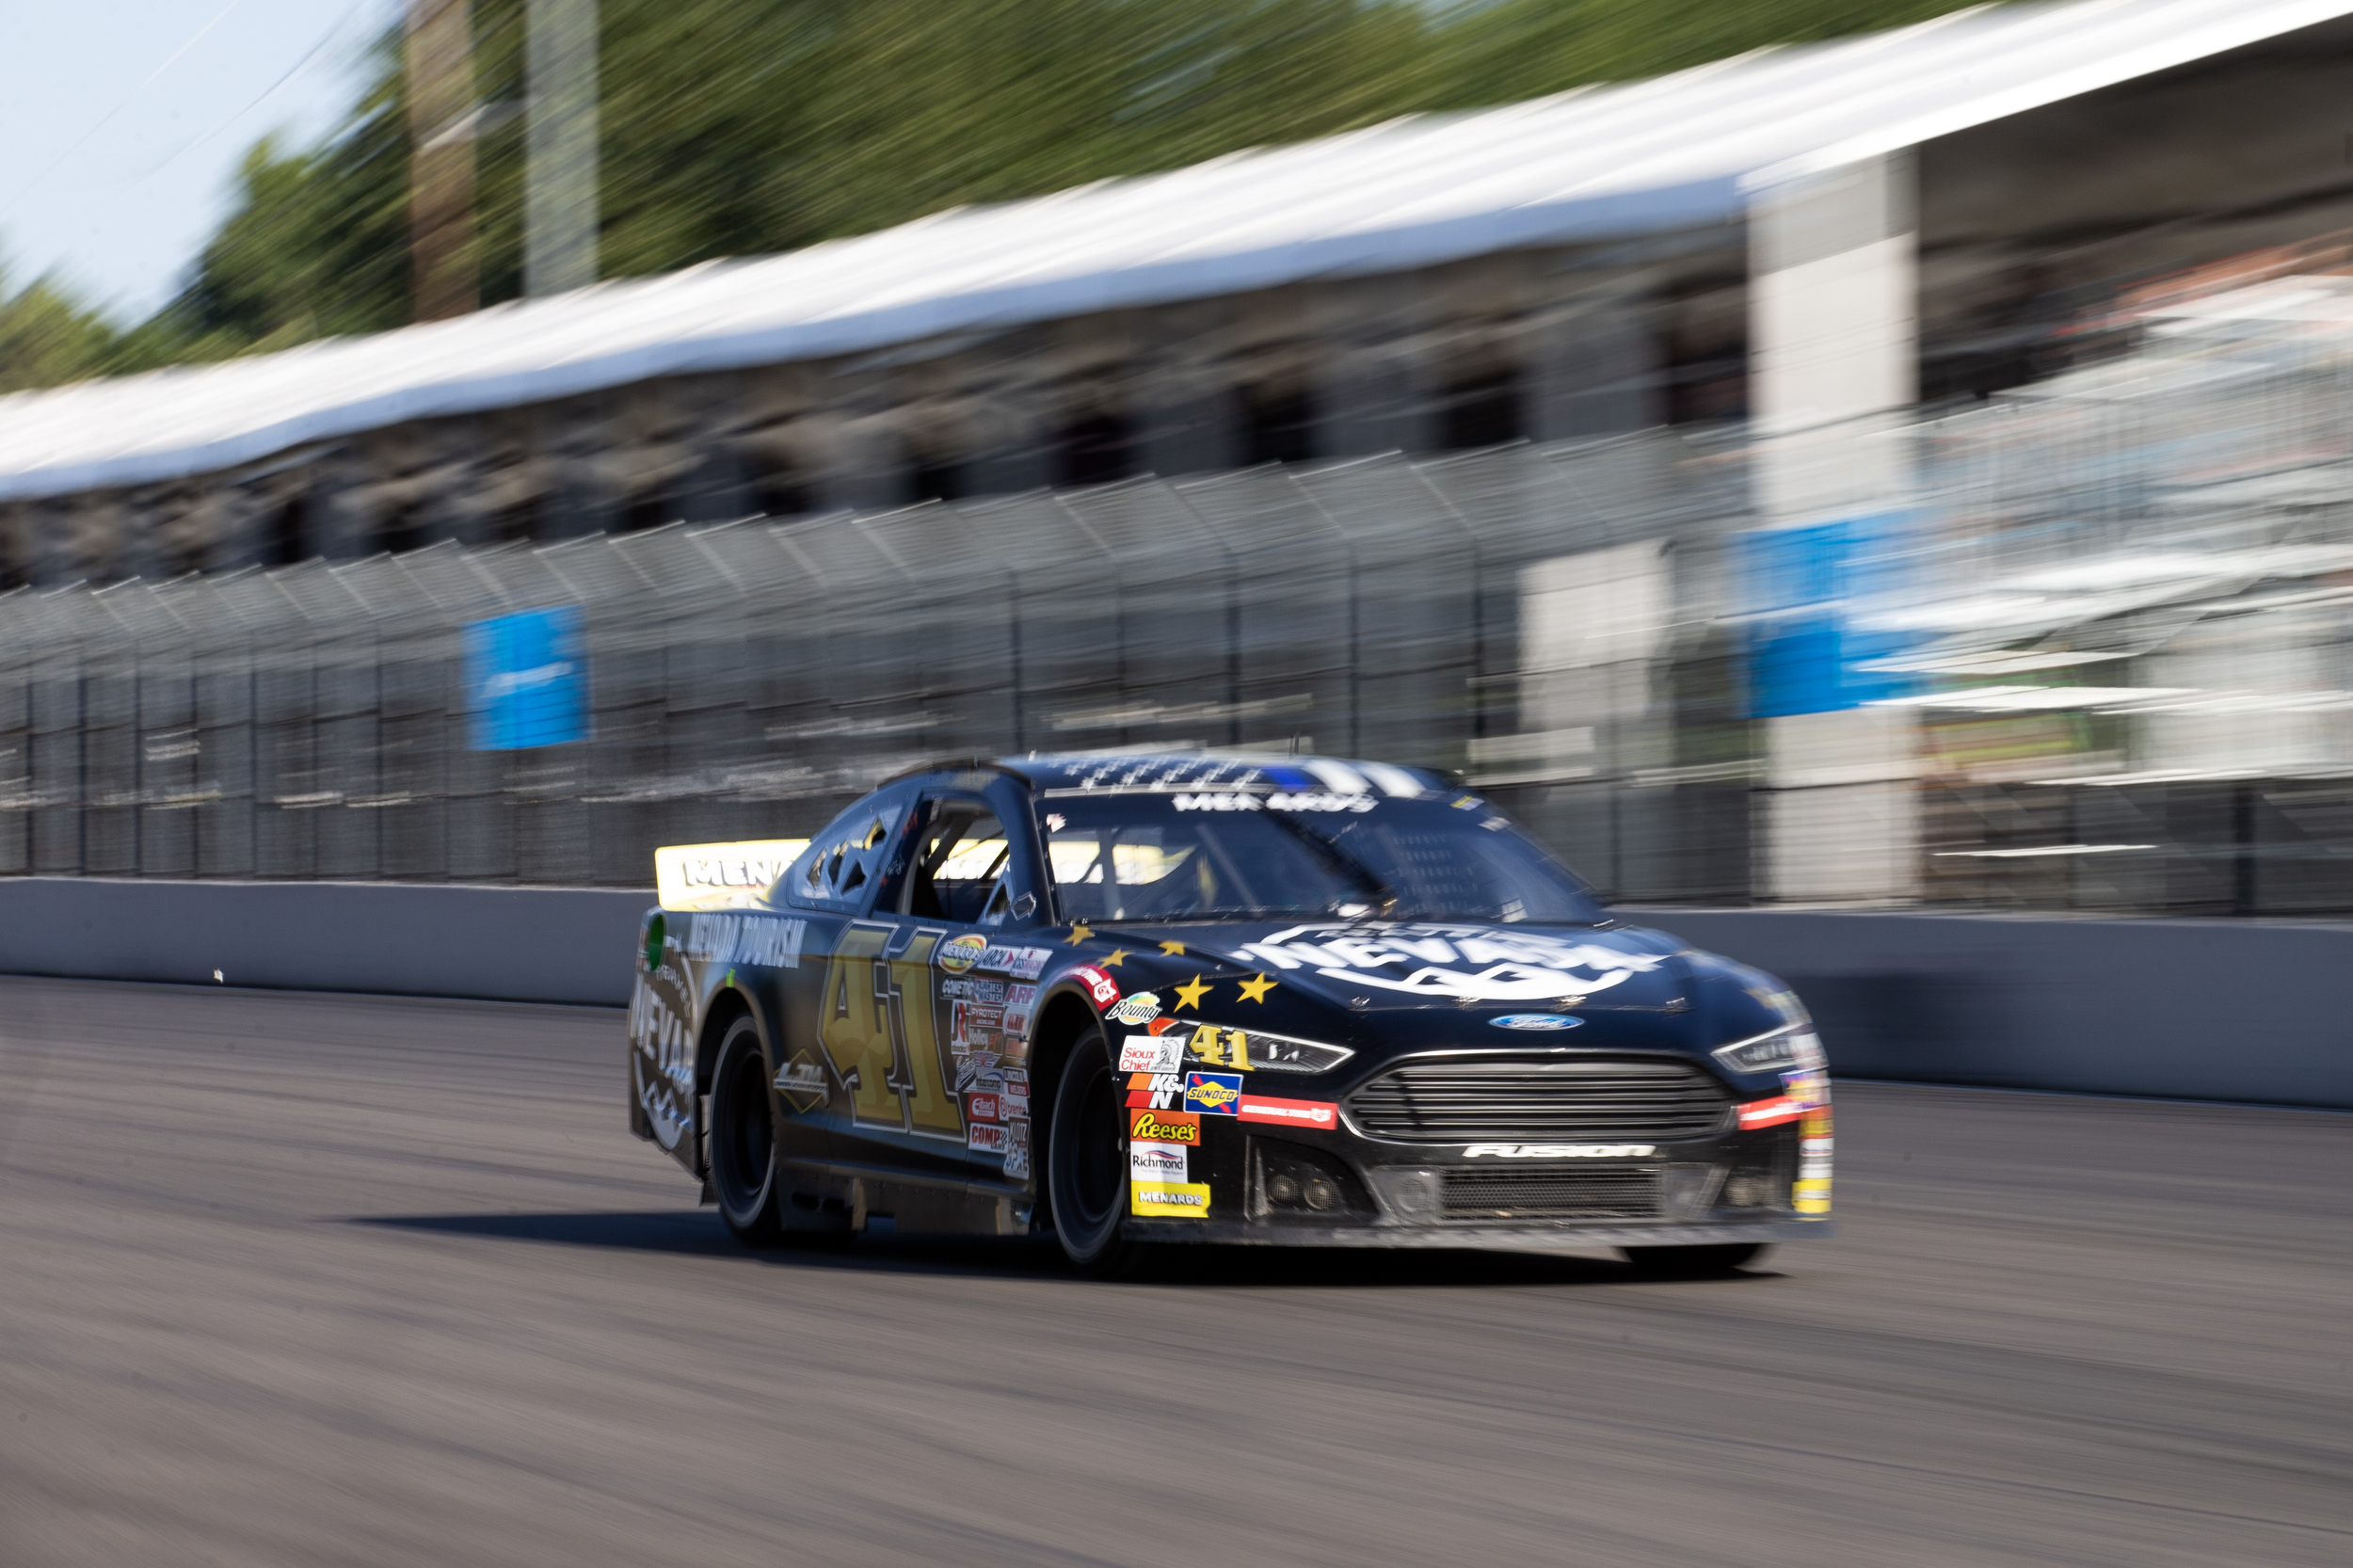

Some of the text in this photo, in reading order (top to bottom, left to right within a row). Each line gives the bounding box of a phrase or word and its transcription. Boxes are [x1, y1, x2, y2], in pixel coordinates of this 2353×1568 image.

[1004, 984, 1036, 1005] ARP
[971, 1007, 1002, 1019] PYROTECT
[1105, 999, 1160, 1024] Bounty
[817, 919, 967, 1143] 41
[1123, 1047, 1156, 1060] Sioux
[1188, 1023, 1256, 1071] 41
[1121, 1059, 1150, 1071] Chief
[1148, 1091, 1175, 1110] N
[1189, 1088, 1237, 1101] SUNOCO
[970, 1126, 1000, 1145] COMP
[1009, 1121, 1028, 1143] KLOTZ
[1131, 1112, 1197, 1141] Reese's
[1461, 1144, 1657, 1158] FUSION
[1132, 1152, 1184, 1171] Richmond
[1138, 1191, 1203, 1206] MENARDS
